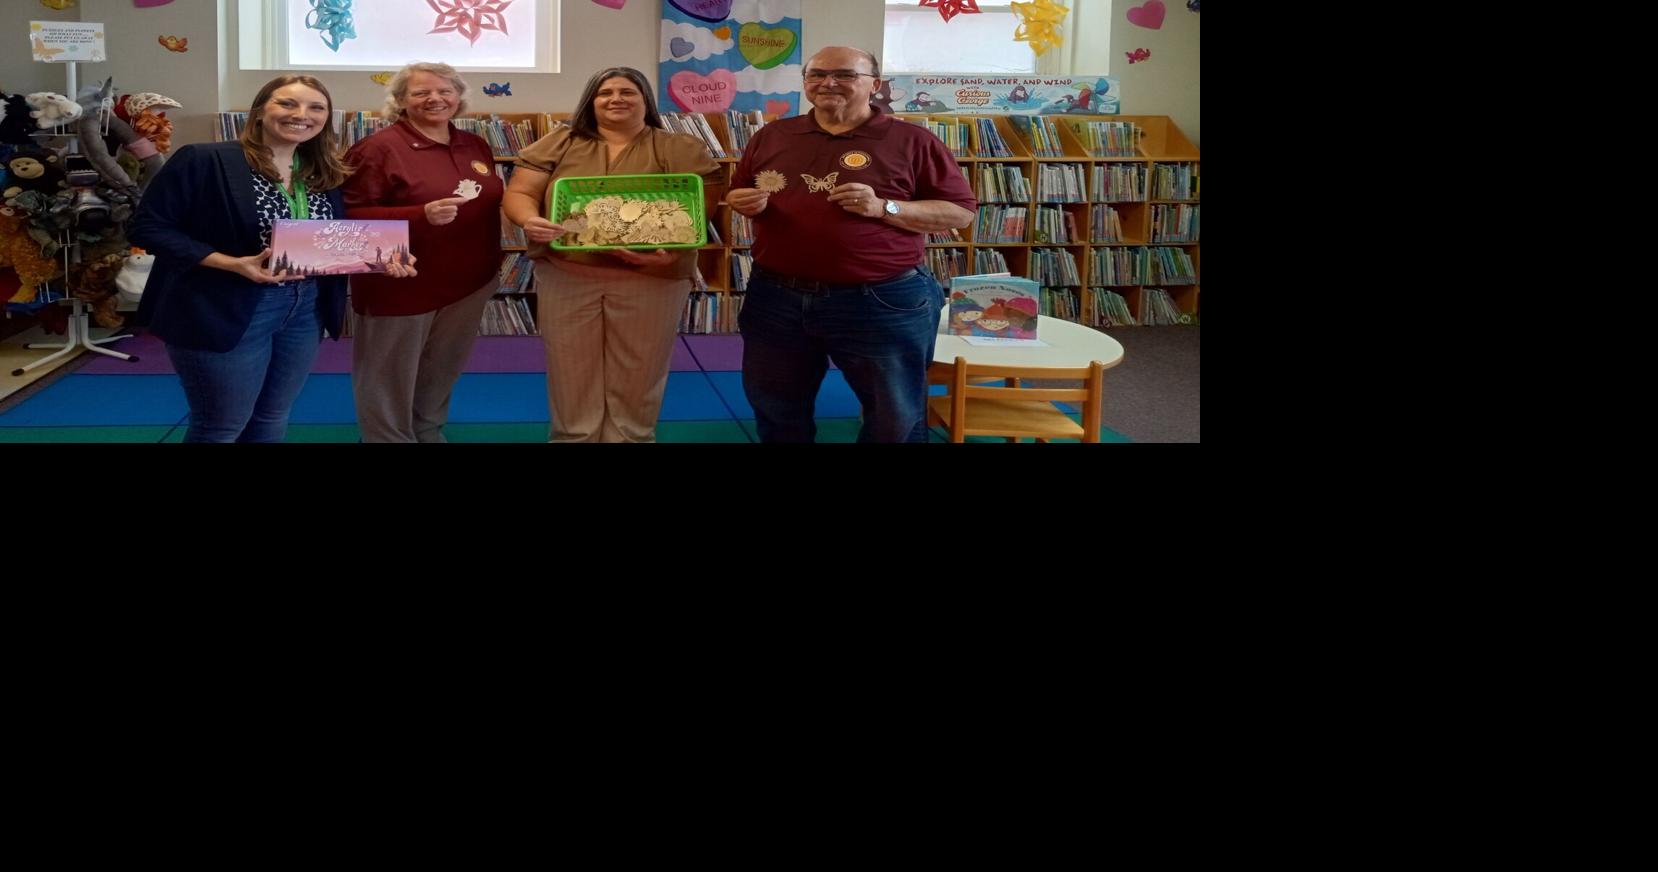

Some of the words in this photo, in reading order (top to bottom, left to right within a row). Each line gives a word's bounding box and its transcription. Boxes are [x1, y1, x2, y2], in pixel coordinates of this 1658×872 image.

[742, 35, 785, 48] SUNSHINE
[915, 77, 957, 85] EXPLORE
[986, 78, 1020, 86] WATER,
[682, 81, 727, 94] CLOUD
[955, 89, 991, 97] Curious
[691, 94, 720, 105] NINE
[957, 97, 990, 106] George
[323, 221, 362, 237] Acrylic
